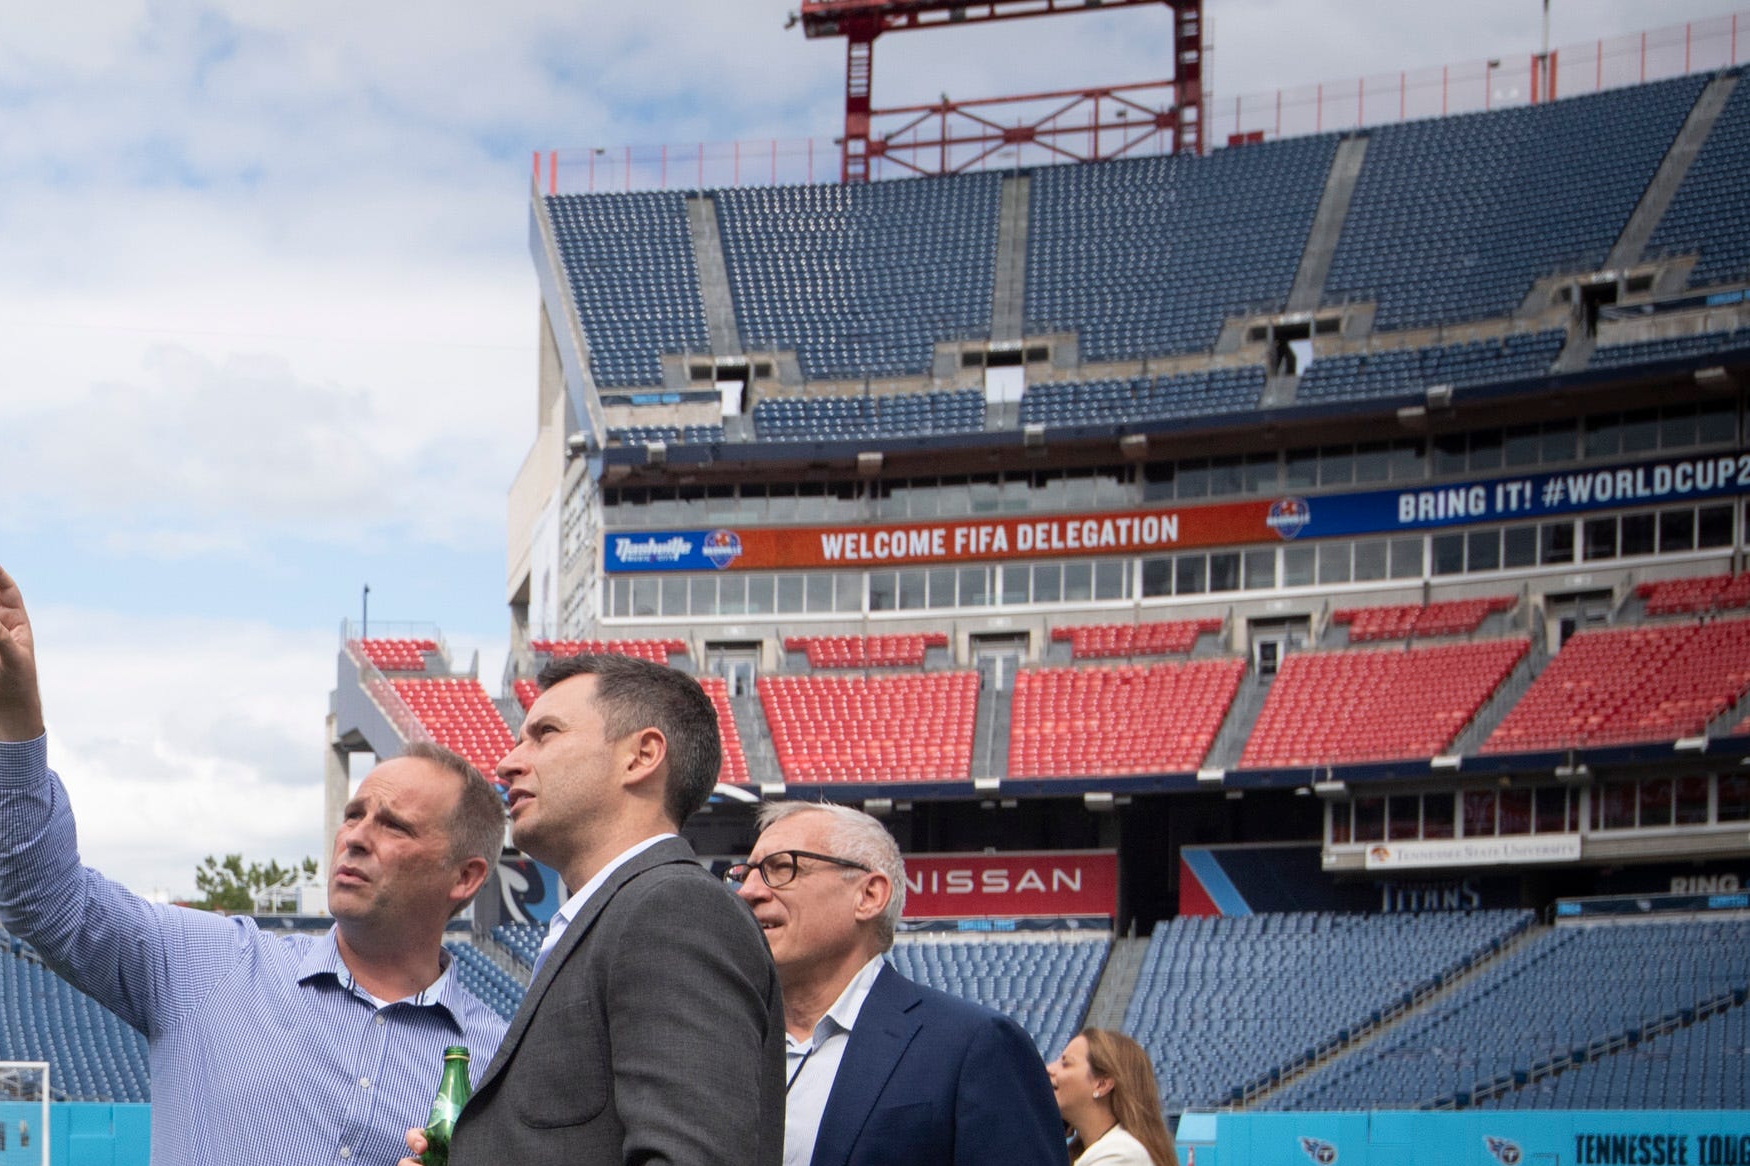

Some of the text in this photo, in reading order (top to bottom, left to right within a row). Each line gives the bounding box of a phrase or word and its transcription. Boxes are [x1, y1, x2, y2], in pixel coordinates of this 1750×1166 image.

[1397, 483, 1488, 524] BRING
[1494, 480, 1533, 514] IT!
[820, 513, 1179, 562] WELCOME FIFA DELEGATION
[905, 868, 1082, 895] NISSAN
[1575, 1133, 1689, 1166] TENNESSEE
